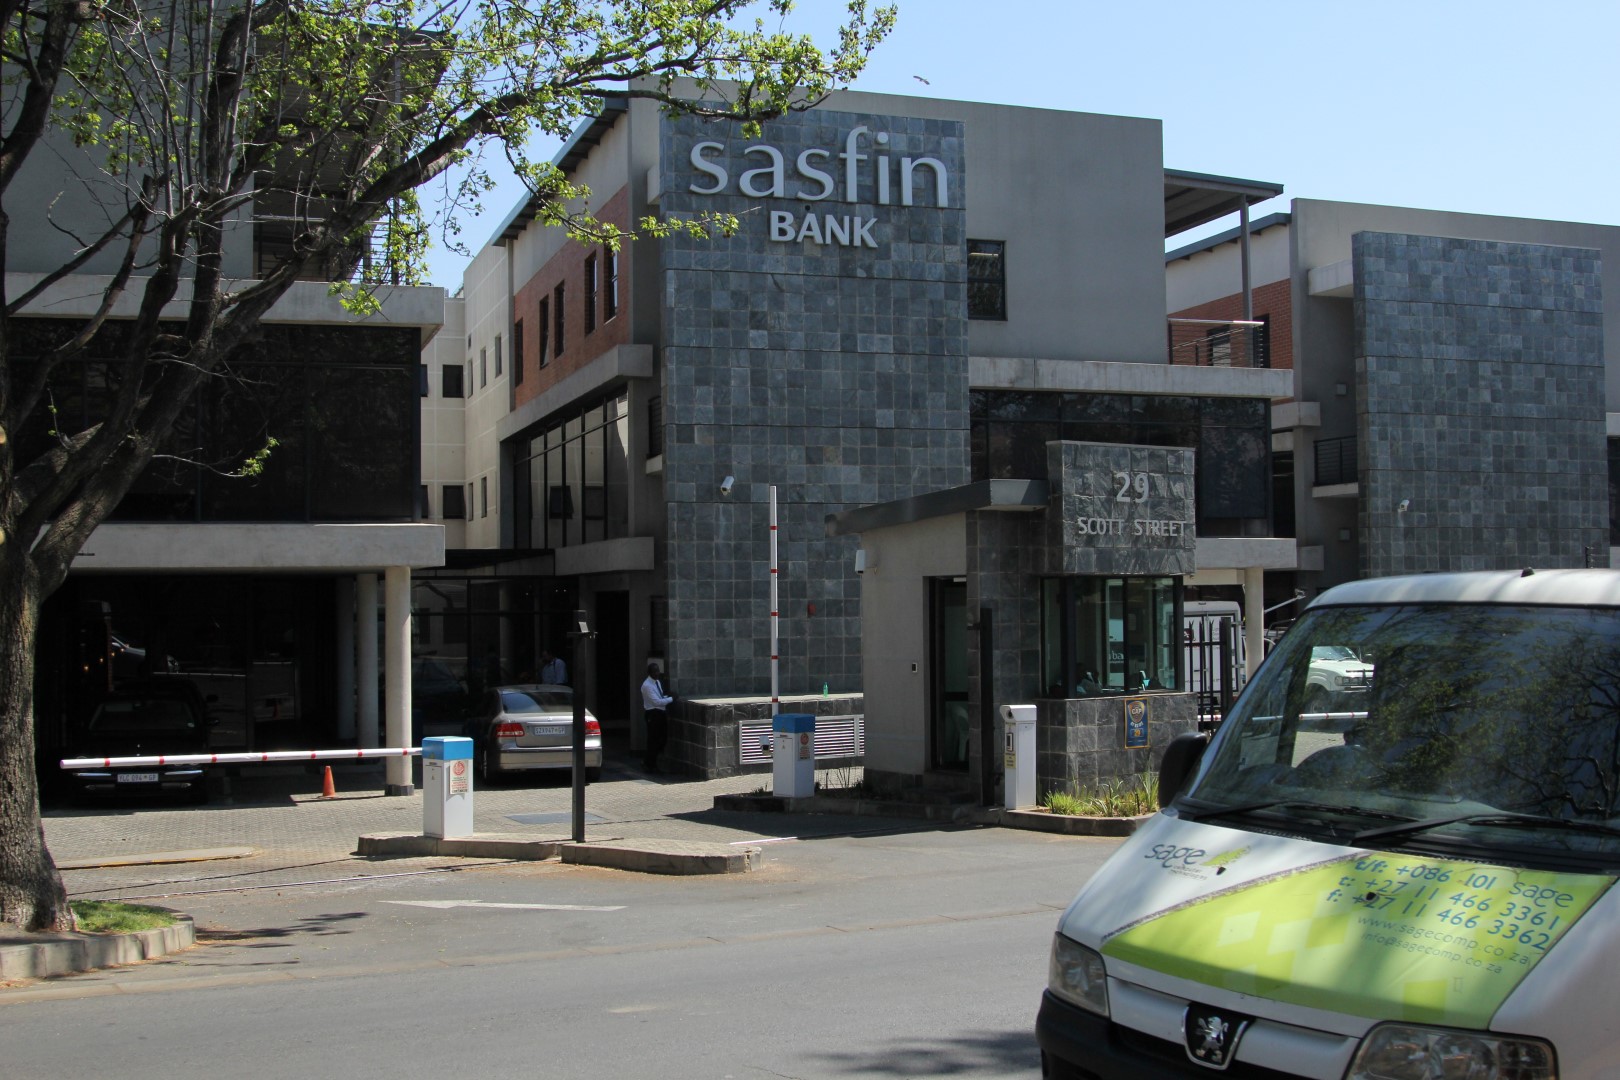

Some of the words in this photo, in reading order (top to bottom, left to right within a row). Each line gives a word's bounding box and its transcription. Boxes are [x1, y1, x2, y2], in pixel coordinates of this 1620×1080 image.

[689, 125, 949, 209] sasfin
[769, 210, 879, 248] BANK
[1115, 471, 1149, 504] 29
[1077, 516, 1125, 536] SCOTT
[1133, 518, 1187, 537] STREET
[1144, 844, 1206, 868] sage
[1365, 878, 1408, 894] +27
[1449, 892, 1492, 912] 466
[1499, 902, 1559, 930] 3361
[1396, 864, 1453, 882] +086
[1509, 881, 1574, 907] sage
[1437, 908, 1480, 928] 466
[1487, 919, 1551, 950] 3362
